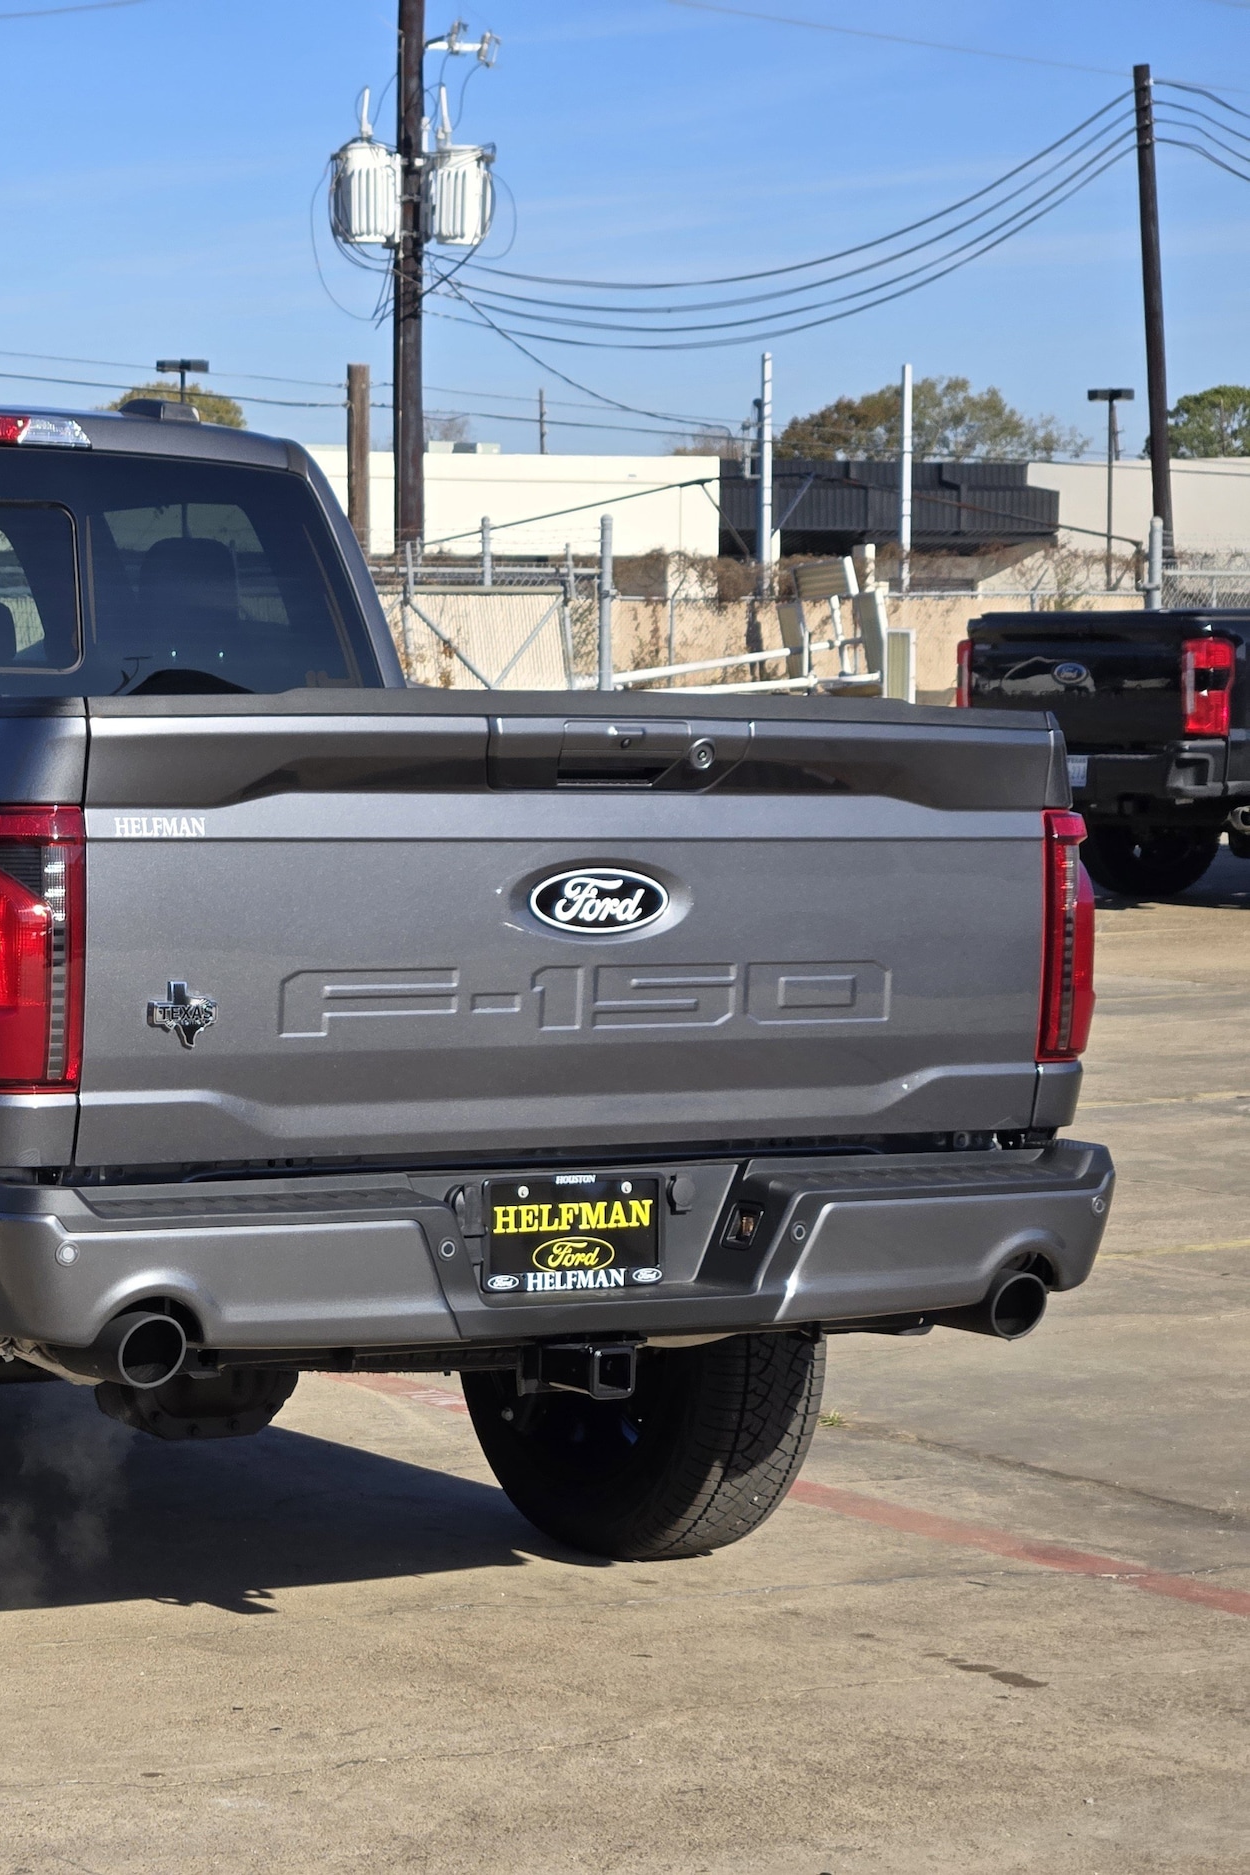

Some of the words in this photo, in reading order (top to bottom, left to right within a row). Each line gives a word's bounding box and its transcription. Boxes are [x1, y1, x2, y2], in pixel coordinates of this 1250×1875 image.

[114, 816, 206, 838] HELFMAN
[553, 876, 646, 922] Ford
[279, 960, 892, 1038] F-150
[159, 1005, 213, 1021] TEXAS
[555, 1174, 597, 1185] HOUSTON
[493, 1199, 653, 1234] HELFMAN
[547, 1241, 601, 1268] Ford
[526, 1267, 627, 1291] HELFMAN
